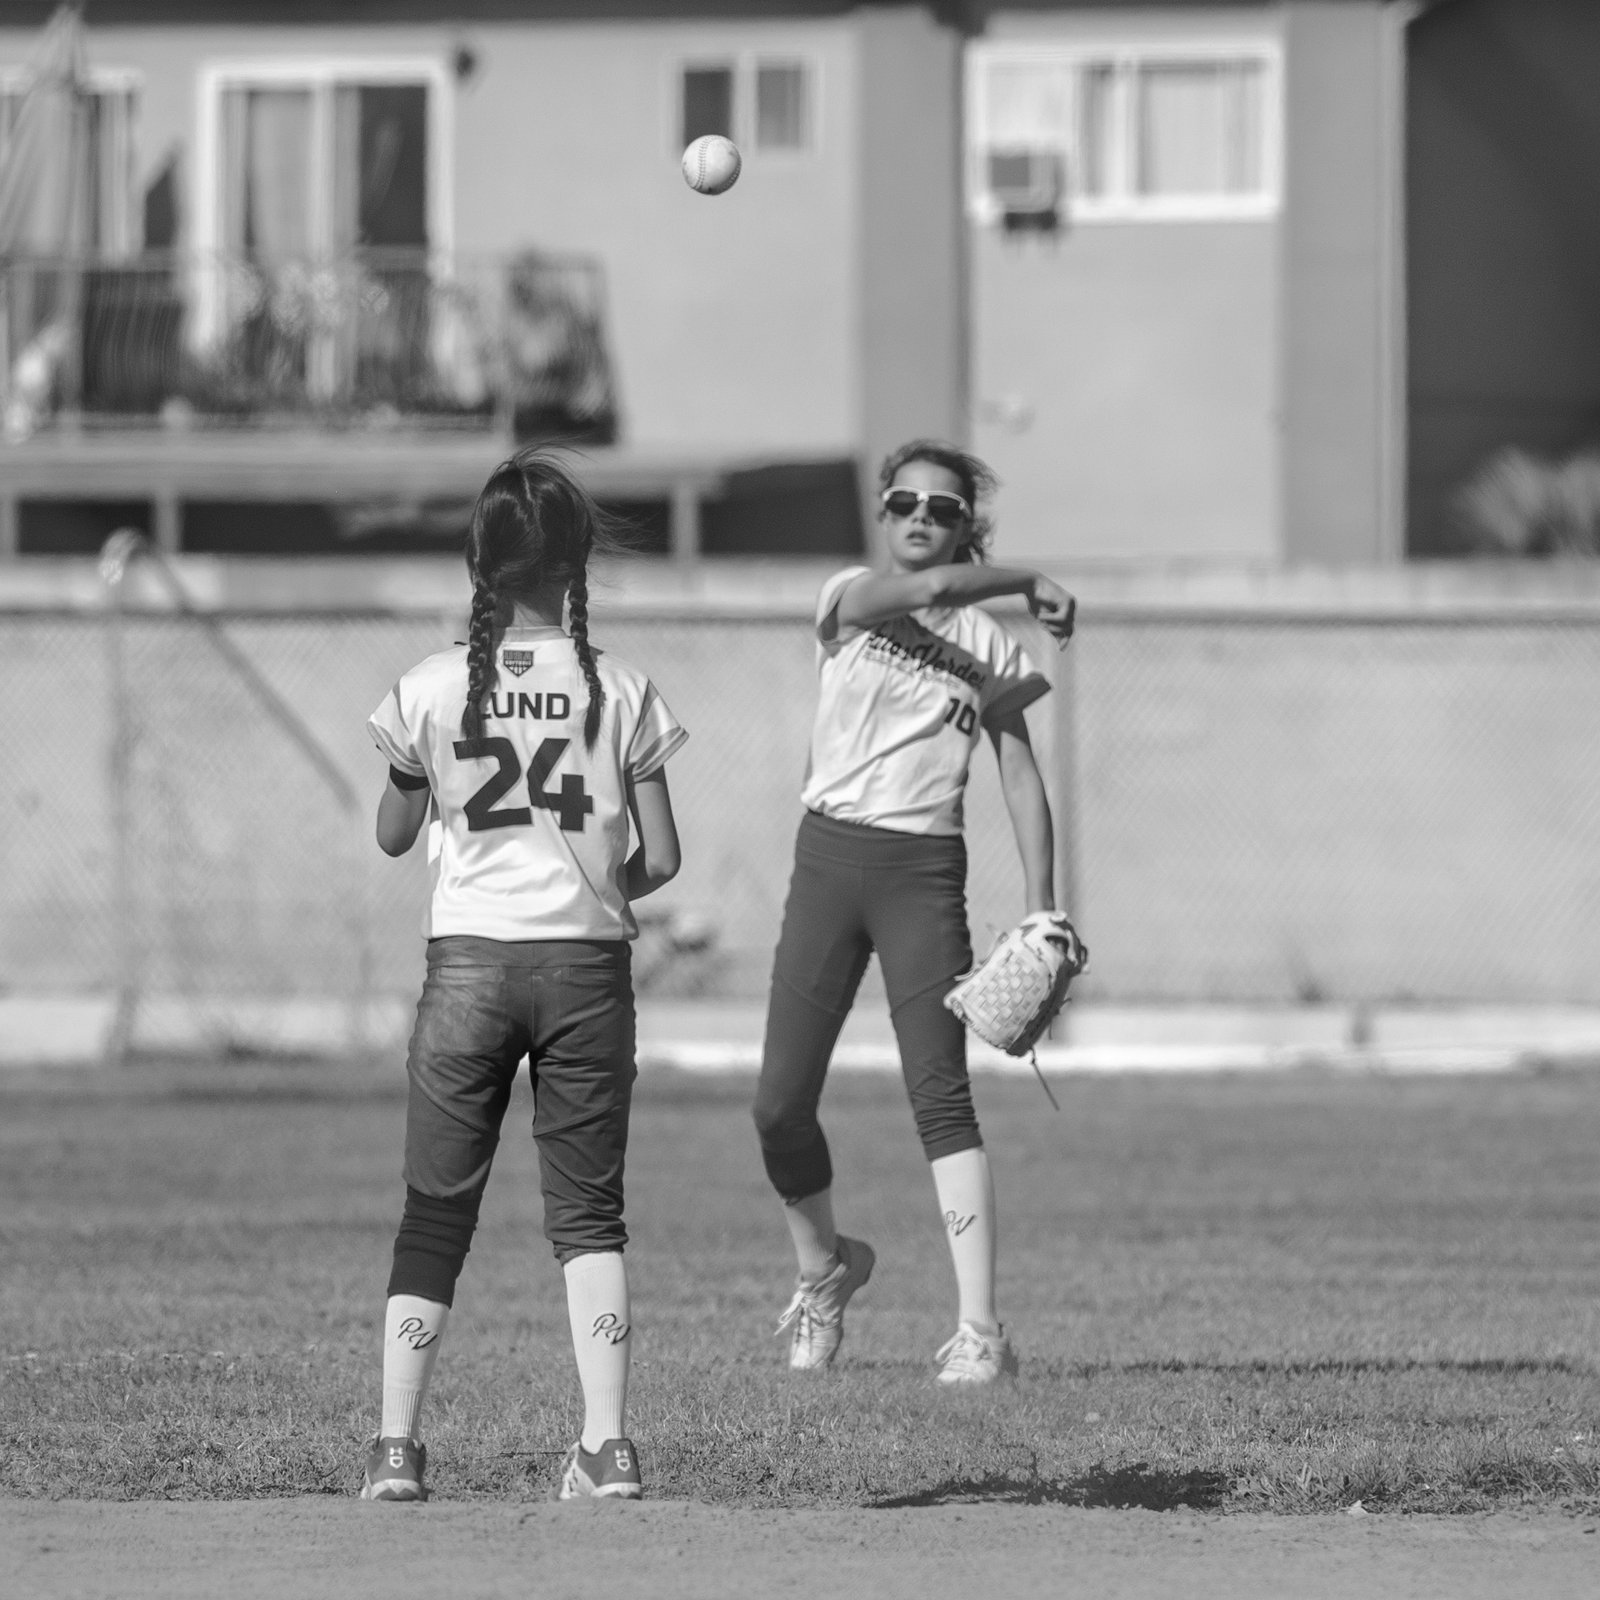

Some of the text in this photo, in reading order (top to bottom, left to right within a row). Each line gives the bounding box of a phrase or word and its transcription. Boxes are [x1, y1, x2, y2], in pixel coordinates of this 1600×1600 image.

[480, 692, 570, 719] UND
[944, 698, 976, 736] 10
[453, 737, 593, 831] 24
